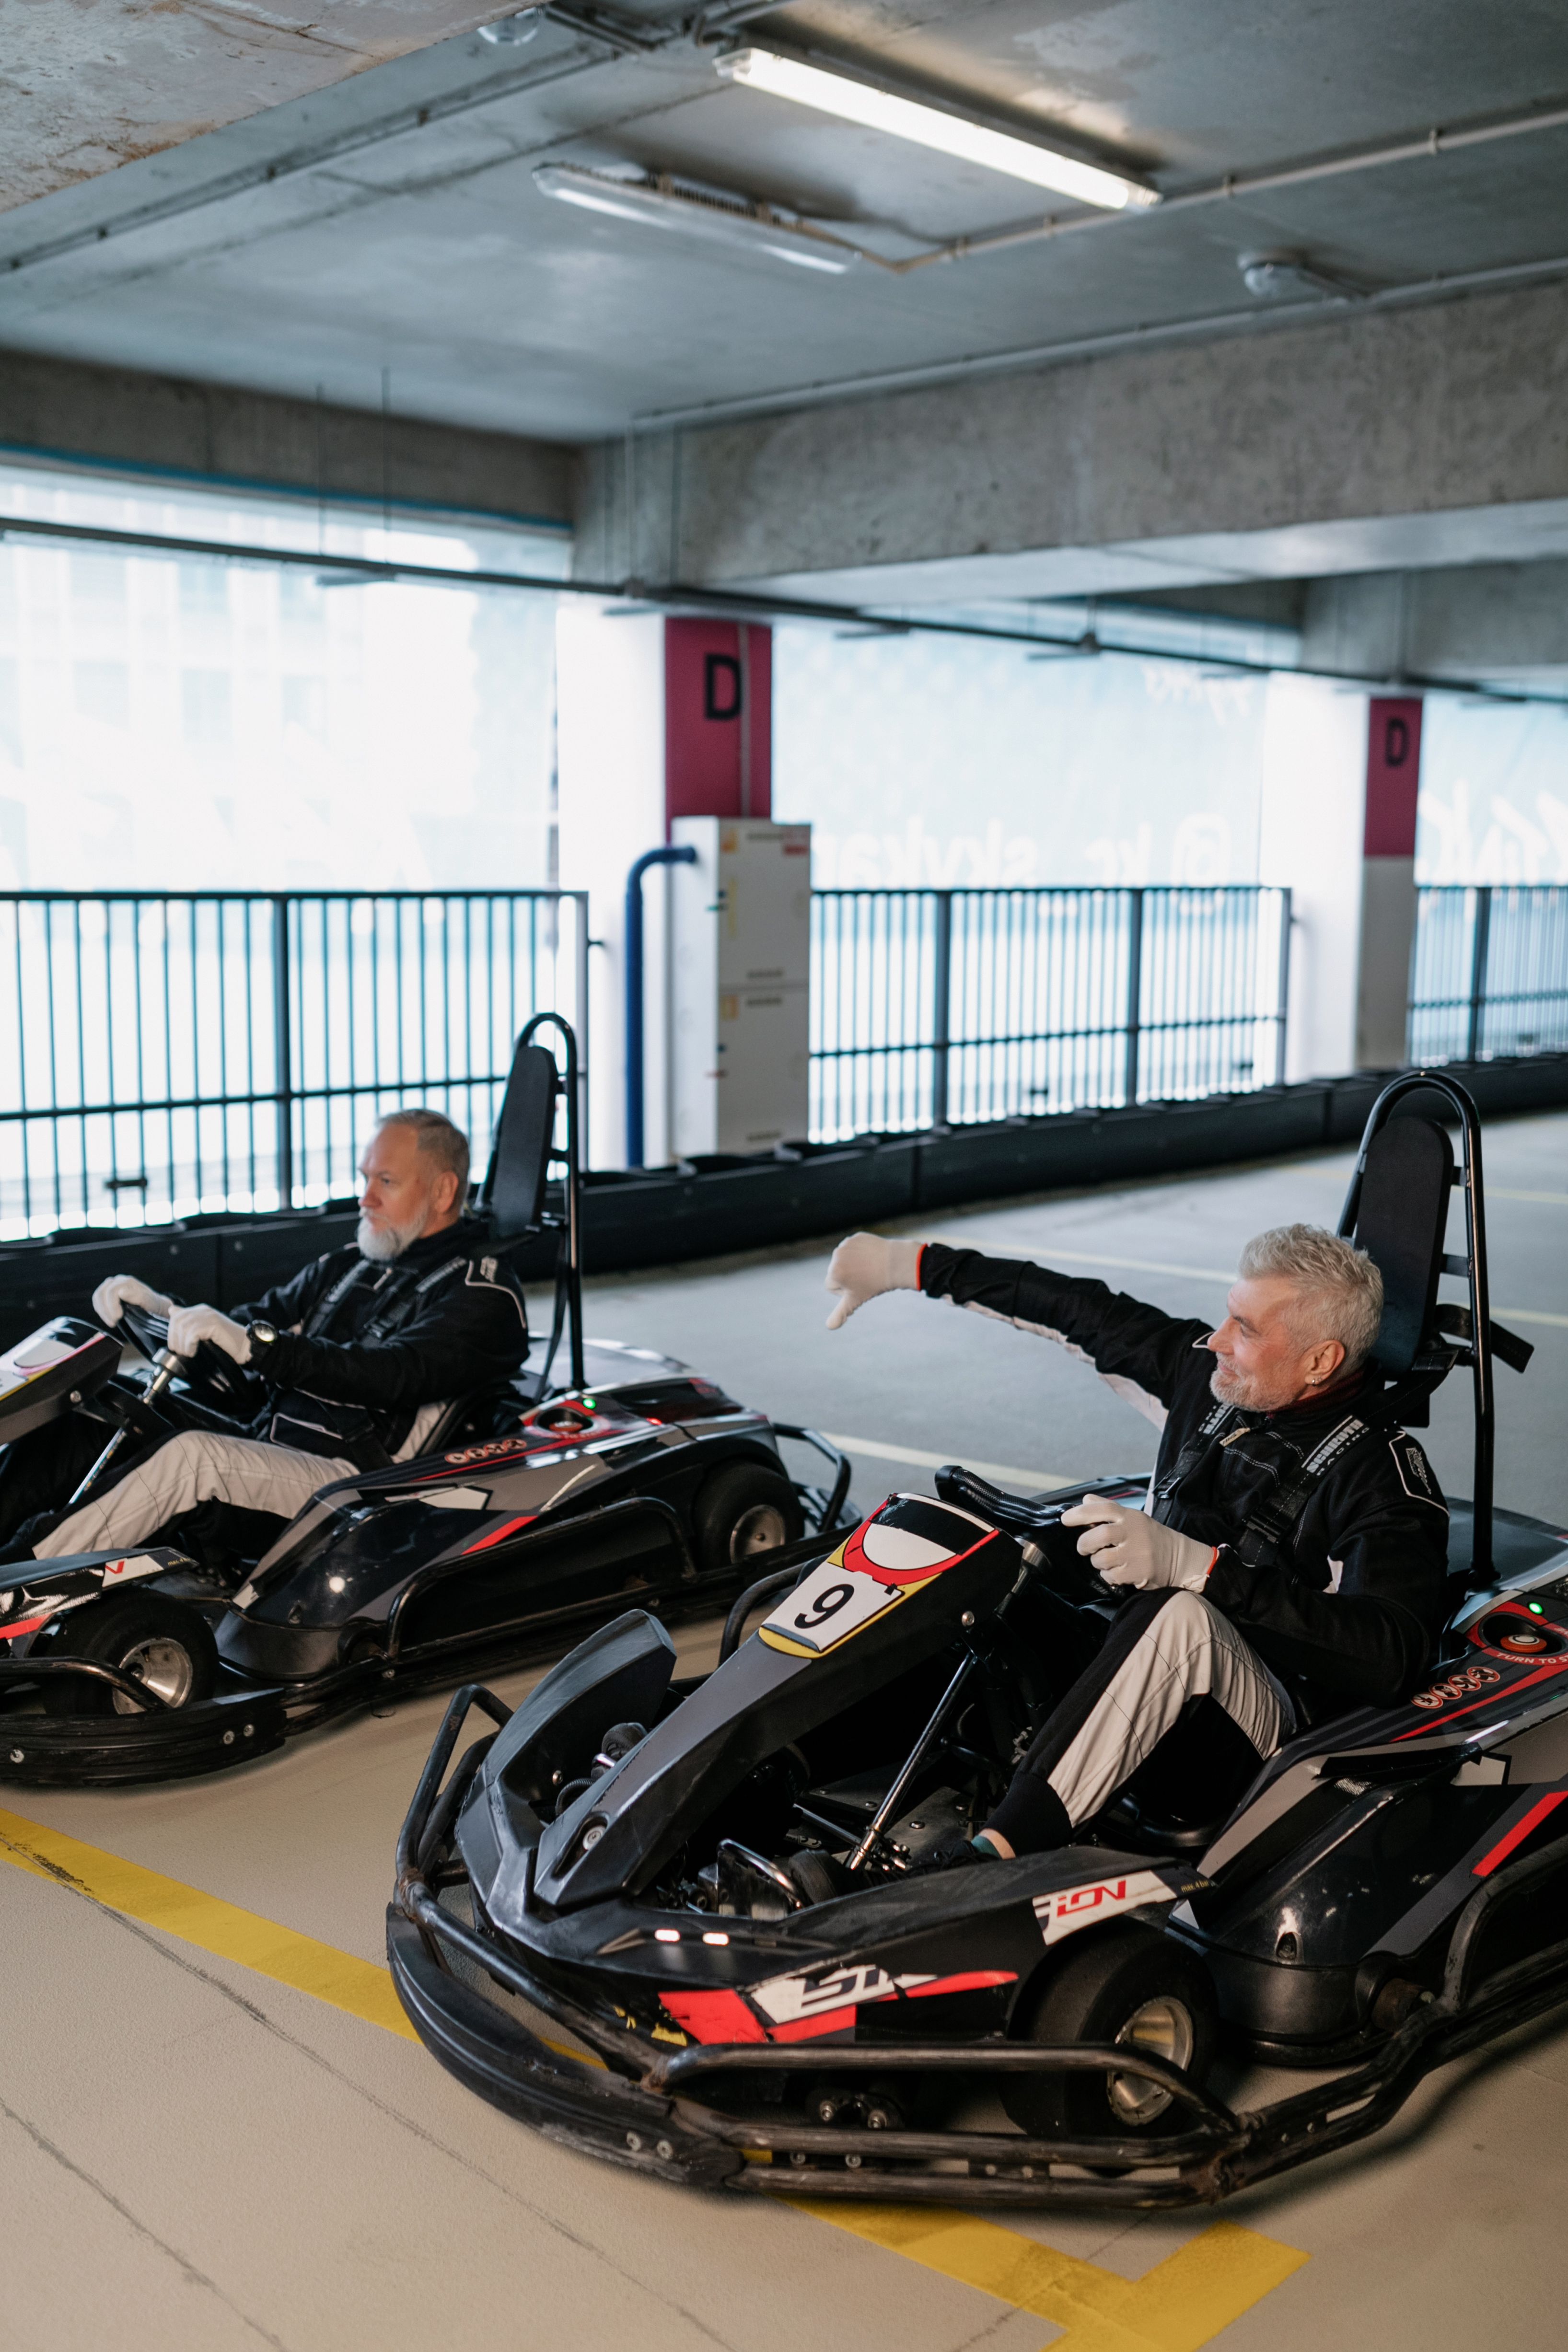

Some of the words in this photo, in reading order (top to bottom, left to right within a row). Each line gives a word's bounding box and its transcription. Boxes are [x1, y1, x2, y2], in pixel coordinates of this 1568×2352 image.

[706, 653, 743, 720] D
[1306, 1419, 1364, 1473] SCHROTH
[1316, 1427, 1370, 1476] RACING
[794, 1583, 855, 1629] 9
[1497, 1652, 1534, 1663] TURN
